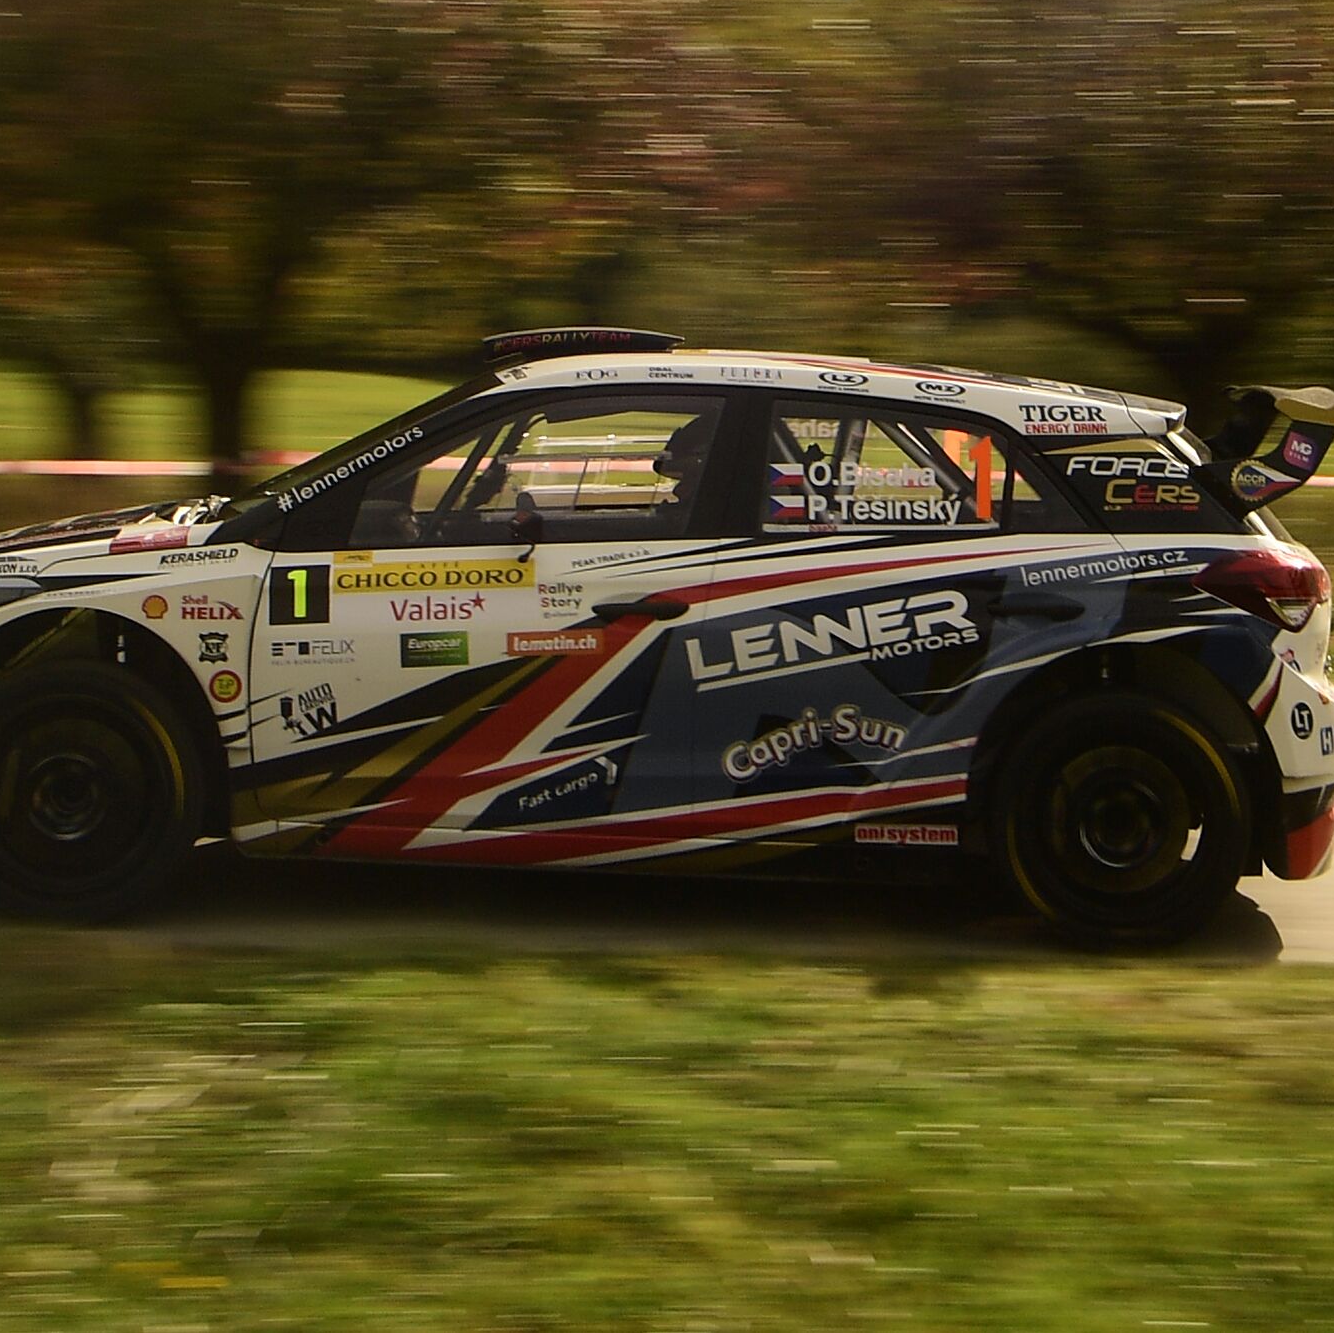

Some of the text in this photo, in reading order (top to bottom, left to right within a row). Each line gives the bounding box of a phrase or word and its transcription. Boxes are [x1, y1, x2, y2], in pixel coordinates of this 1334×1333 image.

[1019, 405, 1107, 422] TIGER
[1025, 423, 1108, 435] ENERGY DRINK
[1291, 440, 1313, 456] MG
[277, 426, 424, 512] #lennermotors
[969, 436, 992, 520] 1
[1066, 456, 1190, 479] FORCE
[1237, 473, 1266, 484] ACCR
[160, 548, 239, 565] KERASHIELD
[1020, 550, 1189, 587] lennermotors.cz
[337, 571, 437, 589] CHICCO
[538, 582, 583, 596] Rallye
[181, 595, 209, 605] Shell
[287, 569, 307, 618] 1
[541, 597, 582, 610] Story
[181, 604, 245, 620] HELIX
[390, 596, 473, 622] Valais
[685, 589, 977, 680] LENNER
[871, 628, 980, 661] MOTORS
[312, 640, 355, 655] FELIX
[298, 682, 333, 707] AUTO
[1294, 708, 1310, 730] LT
[724, 705, 909, 782] Capri-Sun
[519, 772, 598, 812] Fast cargo
